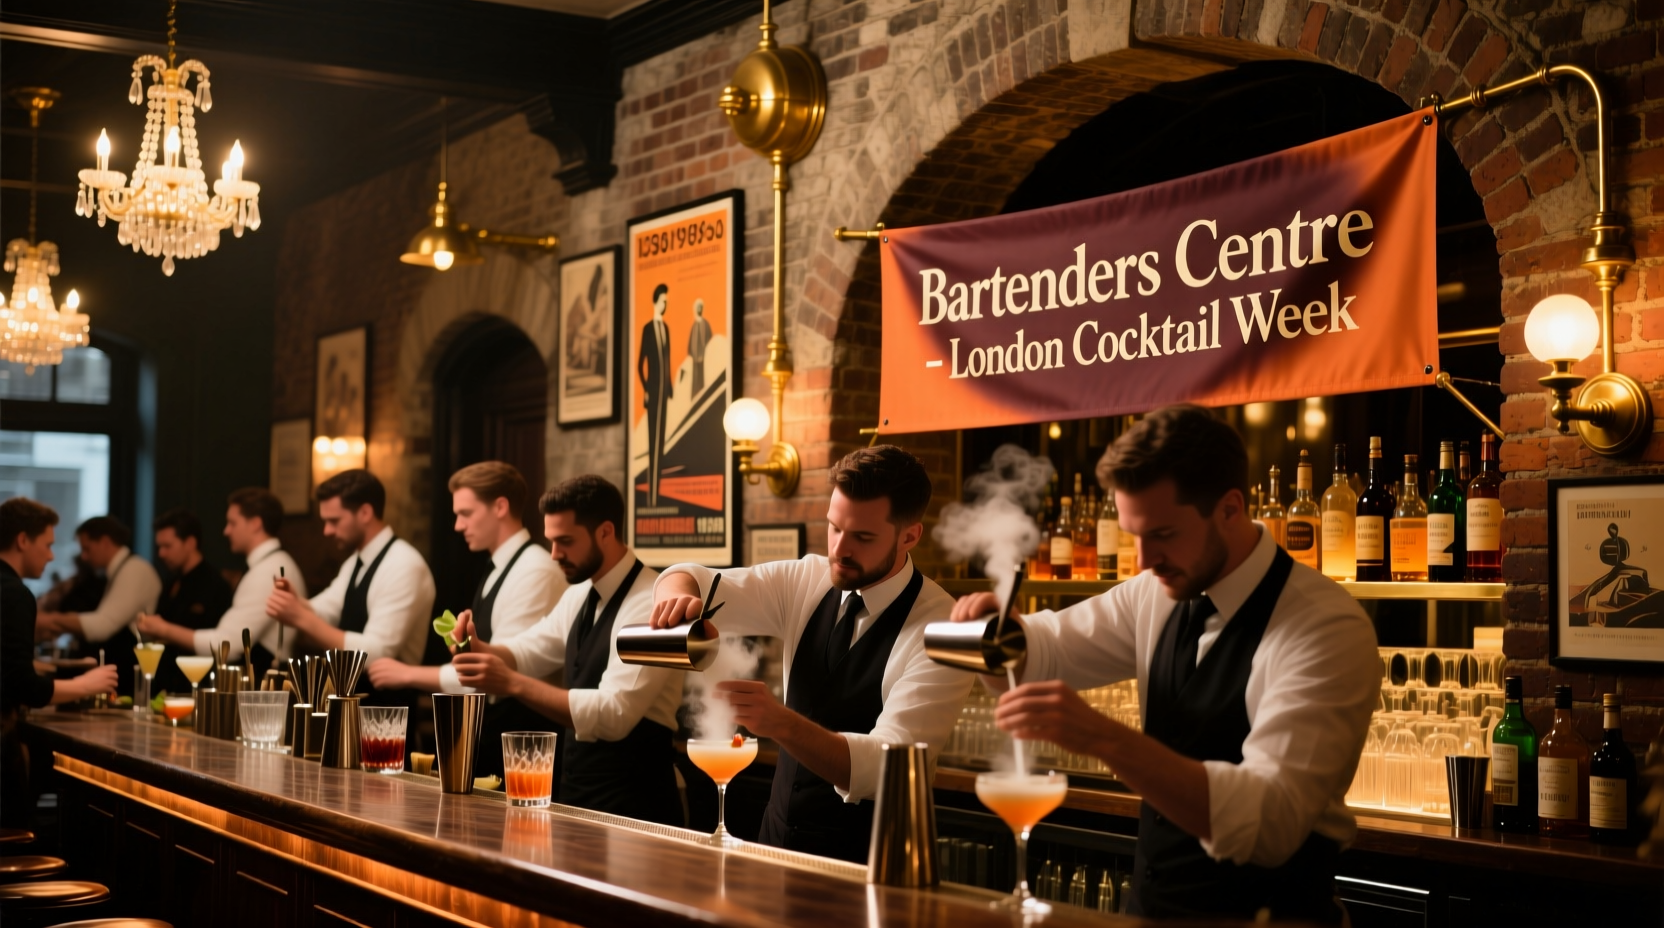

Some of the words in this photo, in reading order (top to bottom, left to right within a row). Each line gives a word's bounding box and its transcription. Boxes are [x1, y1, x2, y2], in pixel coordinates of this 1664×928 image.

[918, 242, 1162, 326] Bartenders
[1175, 209, 1375, 288] Centre
[948, 328, 1065, 380] London
[1072, 298, 1222, 366] Cocktail
[1229, 281, 1360, 345] Week
